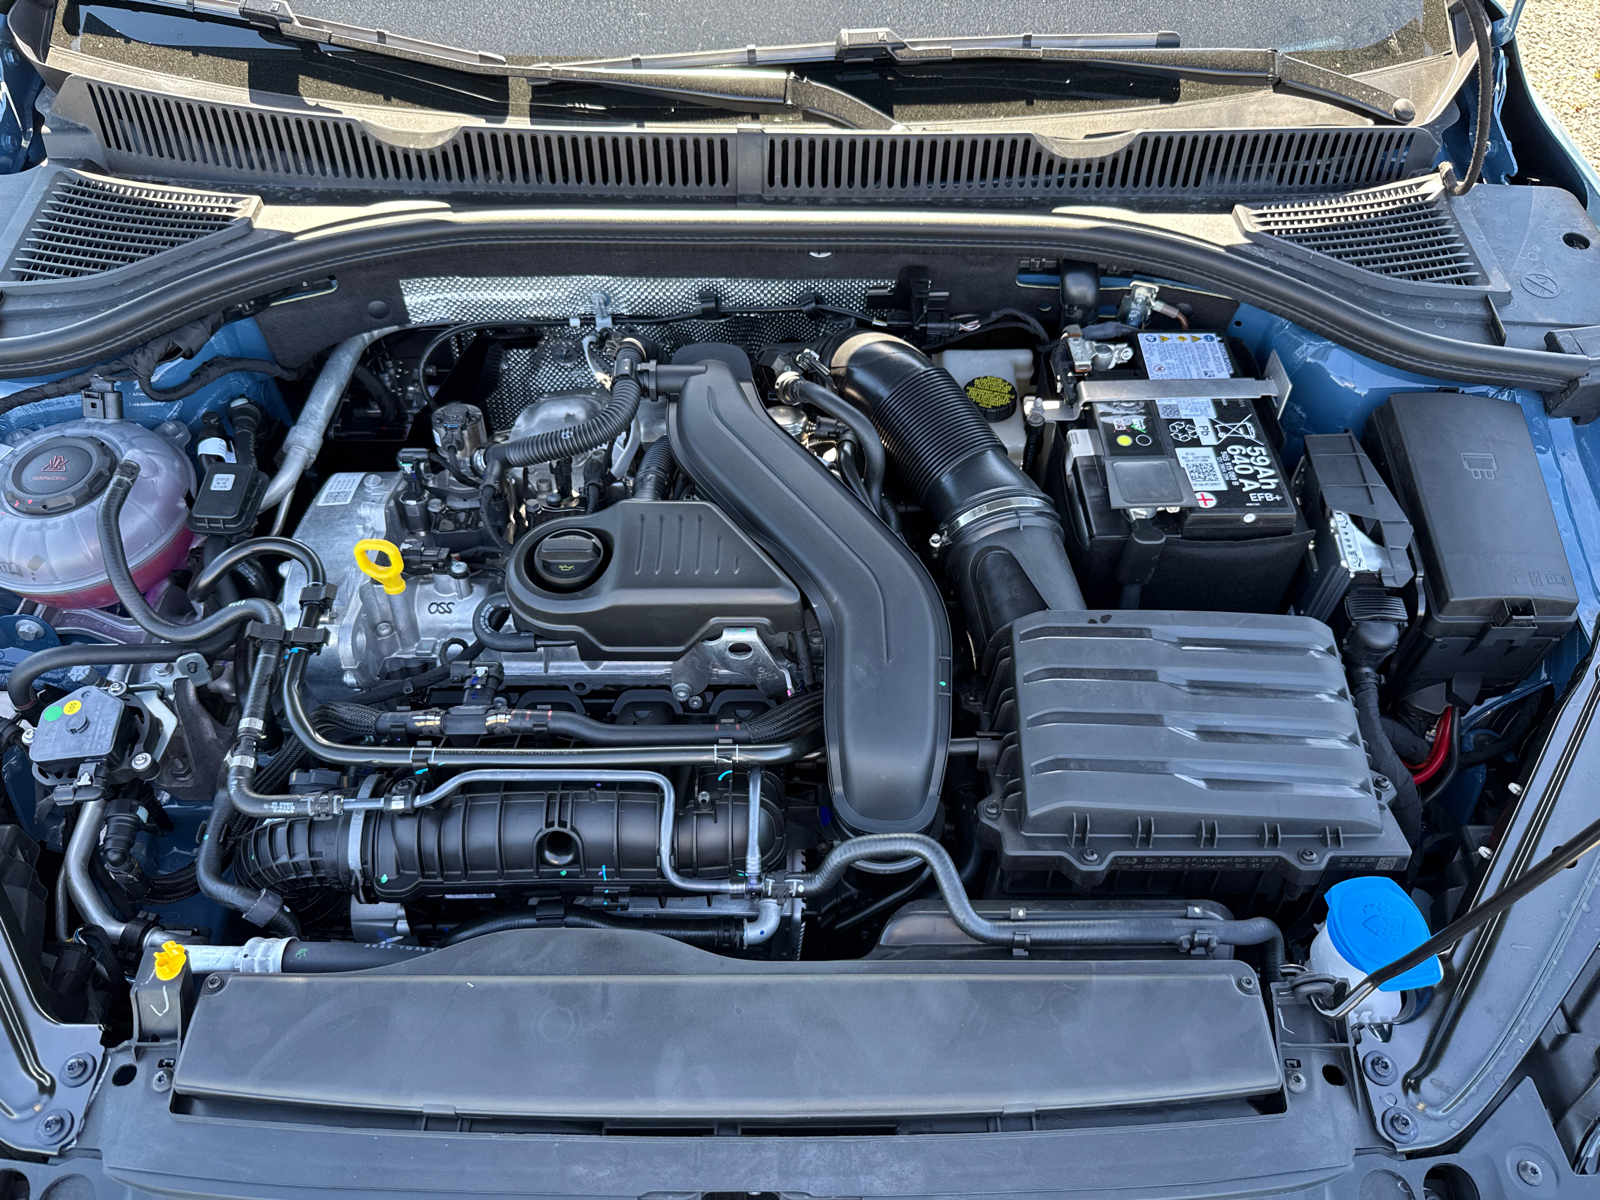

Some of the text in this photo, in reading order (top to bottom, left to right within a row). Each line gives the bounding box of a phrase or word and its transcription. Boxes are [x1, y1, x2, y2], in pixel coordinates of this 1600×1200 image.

[1198, 425, 1210, 436] Pb
[1227, 445, 1254, 474] 640
[1246, 446, 1279, 489] 59Ah
[1238, 478, 1261, 492] A
[1249, 492, 1282, 502] EFB+
[427, 601, 455, 615] OSS
